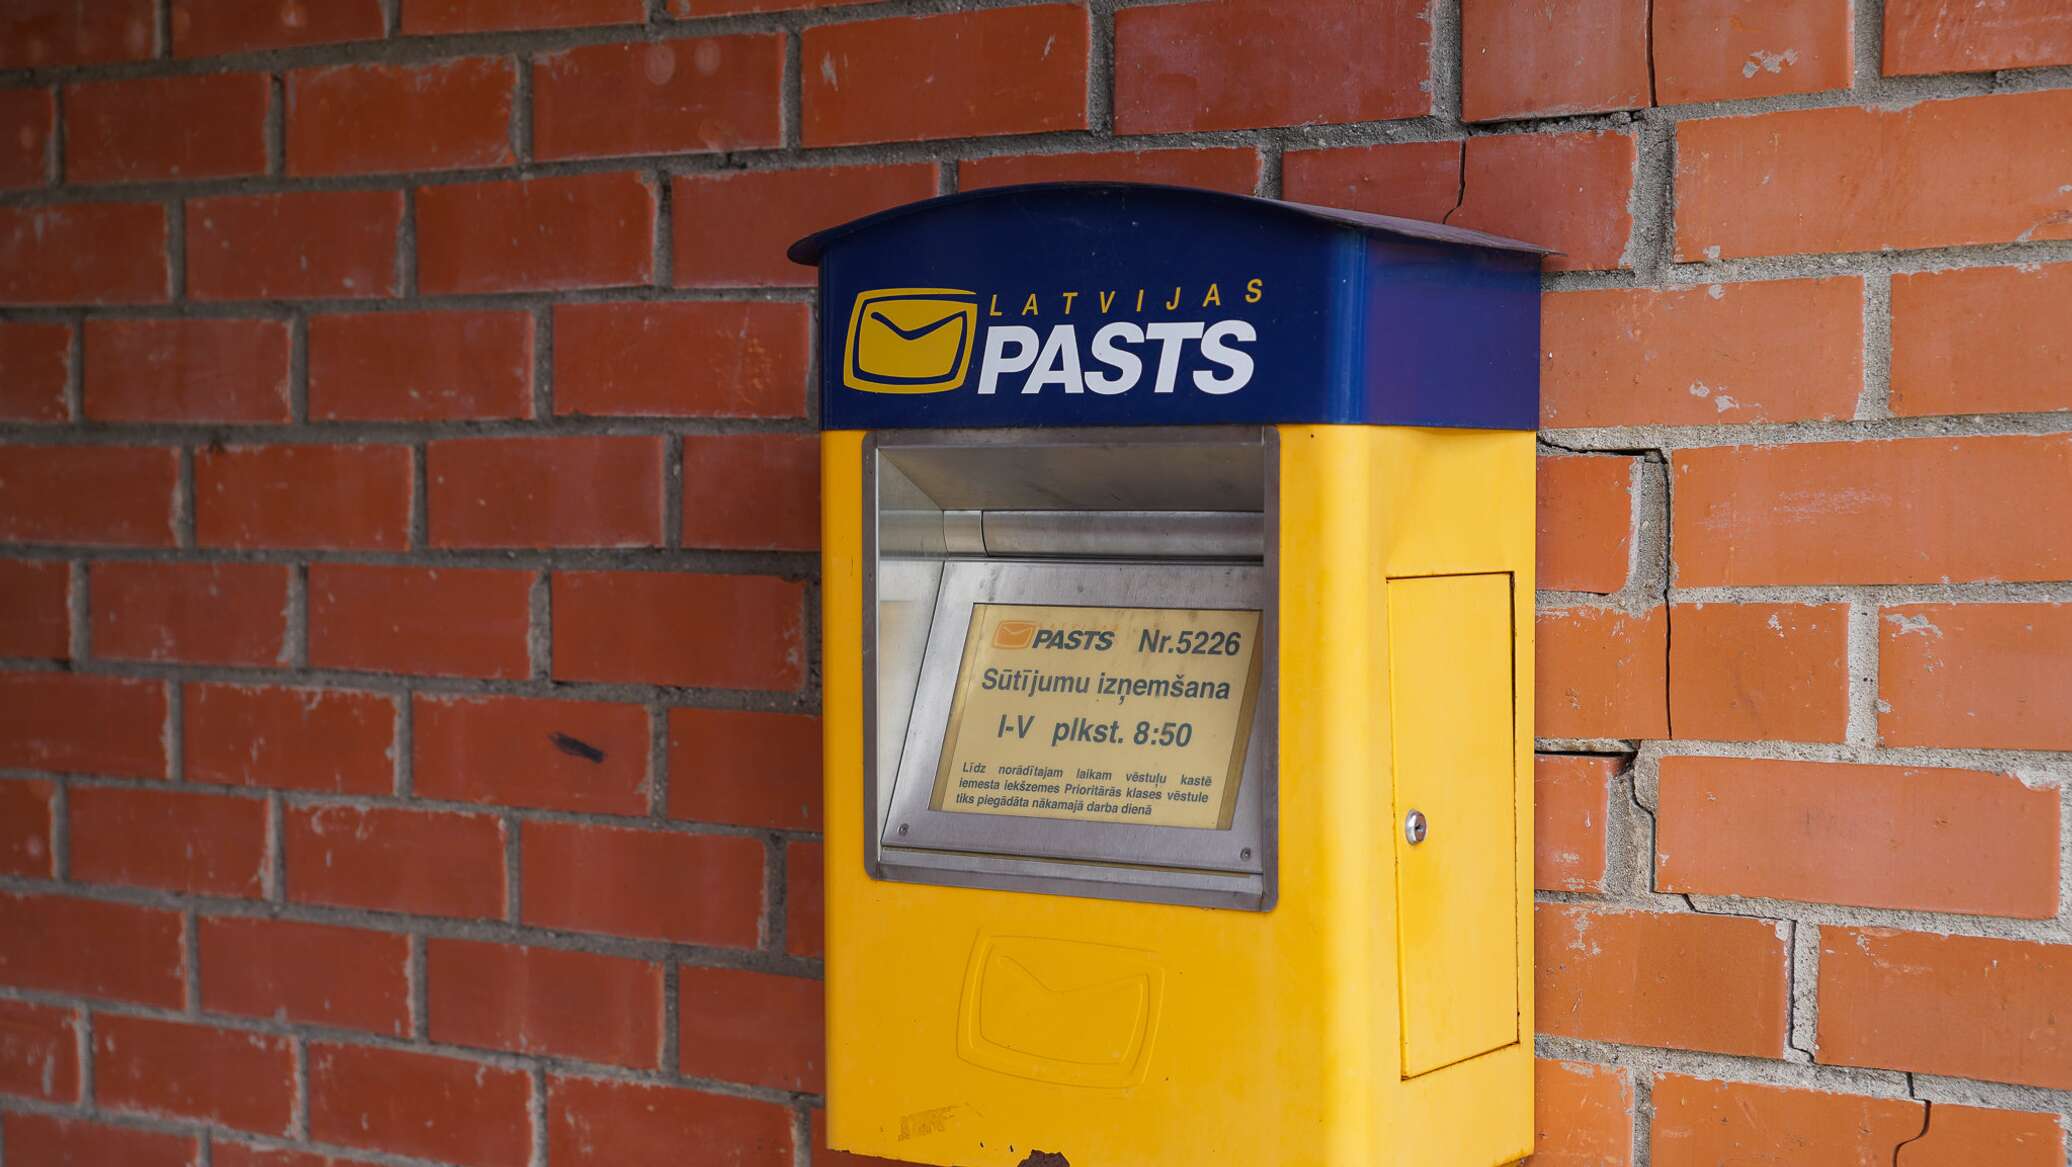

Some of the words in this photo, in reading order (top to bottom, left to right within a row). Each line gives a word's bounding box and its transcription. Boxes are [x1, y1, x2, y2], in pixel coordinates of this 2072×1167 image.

[990, 278, 1264, 317] LATVIJAS
[977, 319, 1257, 395] PASTS
[1031, 629, 1115, 651] PASTS
[1138, 628, 1242, 657] Nr.5226
[981, 668, 1090, 698] Sūtījumu
[1097, 672, 1231, 705] izņemšana
[997, 714, 1035, 739] I-V
[1052, 718, 1124, 747] plkst.
[1133, 721, 1193, 748] 8:50
[962, 762, 987, 774] Līdz
[998, 764, 1064, 780] norādītajam
[1076, 768, 1113, 781] laikam
[1125, 772, 1167, 788] vēstuļu
[1180, 774, 1213, 787] kastē
[956, 793, 975, 805] tiks
[977, 794, 1029, 809] piegādāta
[1032, 798, 1084, 813] nākamajā
[1087, 801, 1118, 814] darba
[1121, 803, 1152, 816] dienā
[959, 778, 1000, 791] iemesta
[1004, 779, 1060, 794] iekšzemes
[1064, 784, 1122, 798] Prioritārās
[1126, 787, 1162, 801] klases
[1167, 791, 1209, 804] vēstule
